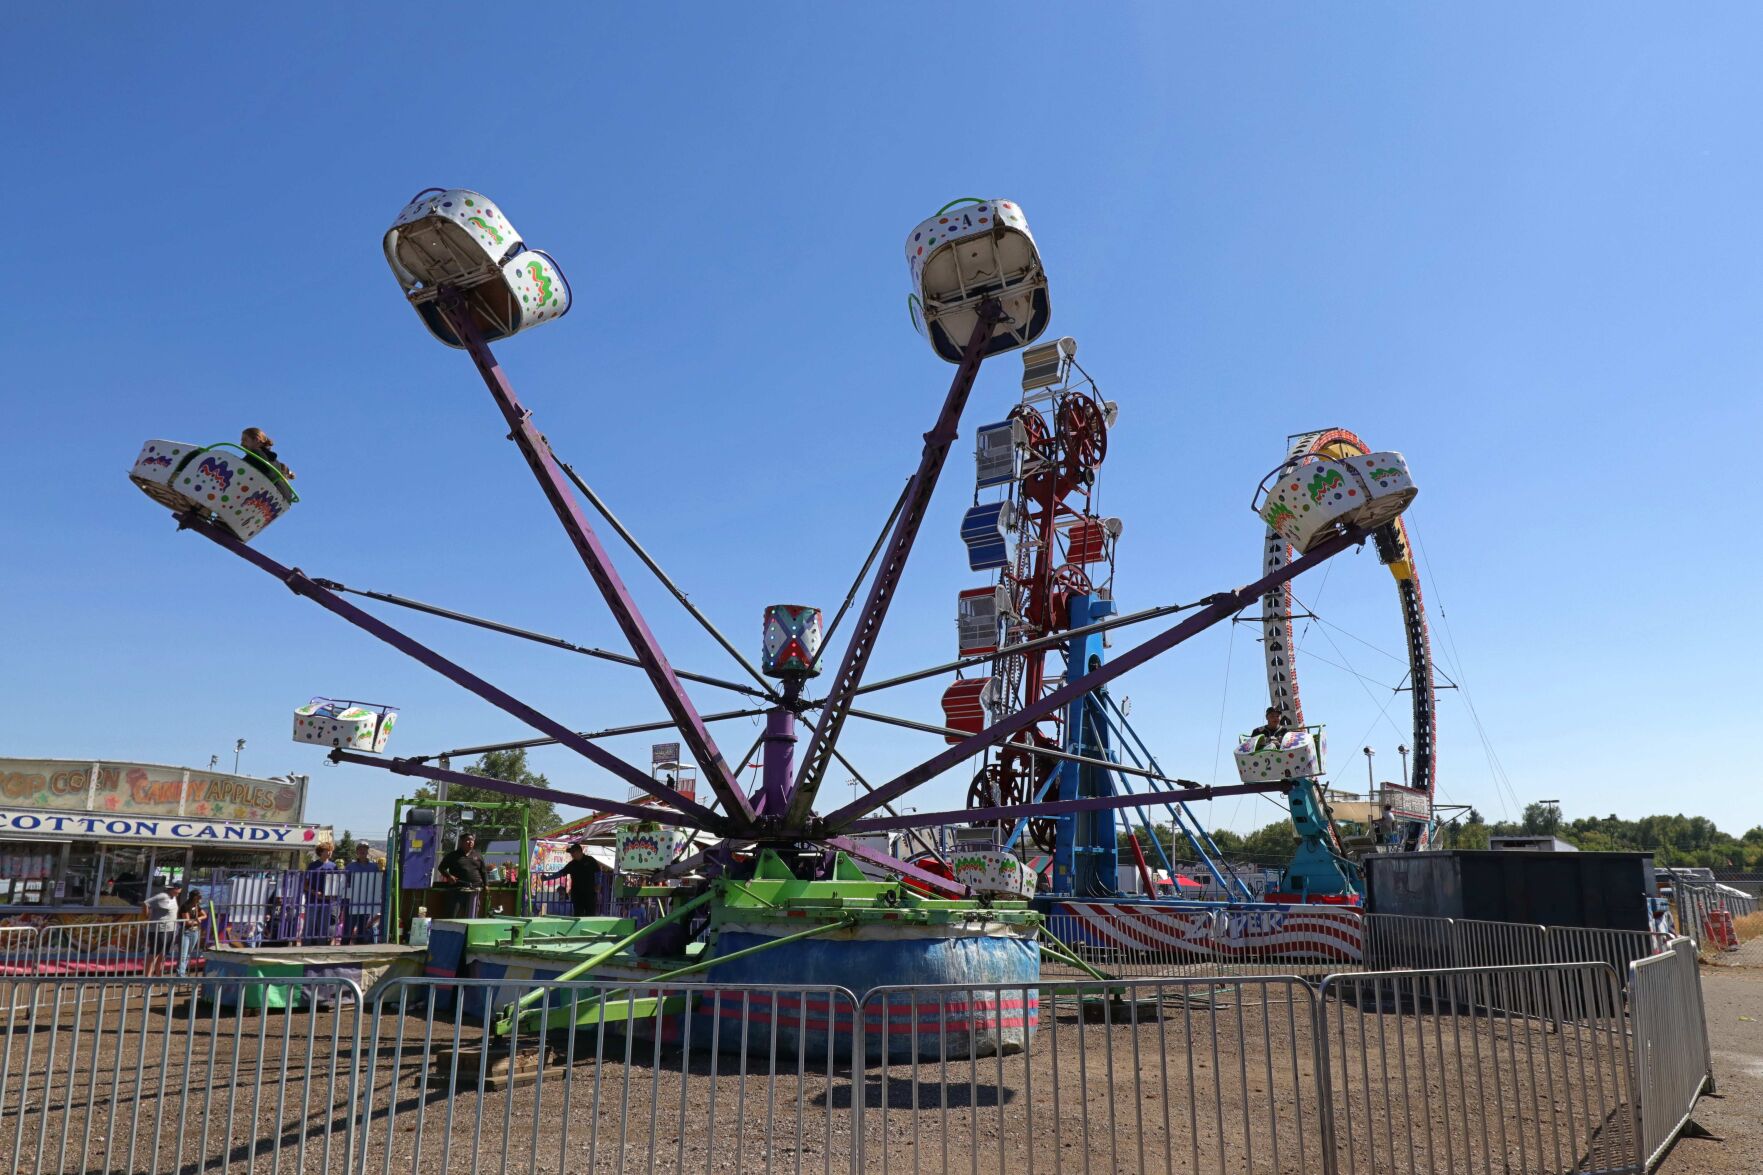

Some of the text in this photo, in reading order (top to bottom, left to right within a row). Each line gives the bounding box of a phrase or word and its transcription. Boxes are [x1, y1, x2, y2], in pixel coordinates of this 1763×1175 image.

[1265, 758, 1271, 770] 2
[0, 771, 47, 798] OP
[207, 779, 274, 810] APPLES
[171, 824, 292, 842] CANDY
